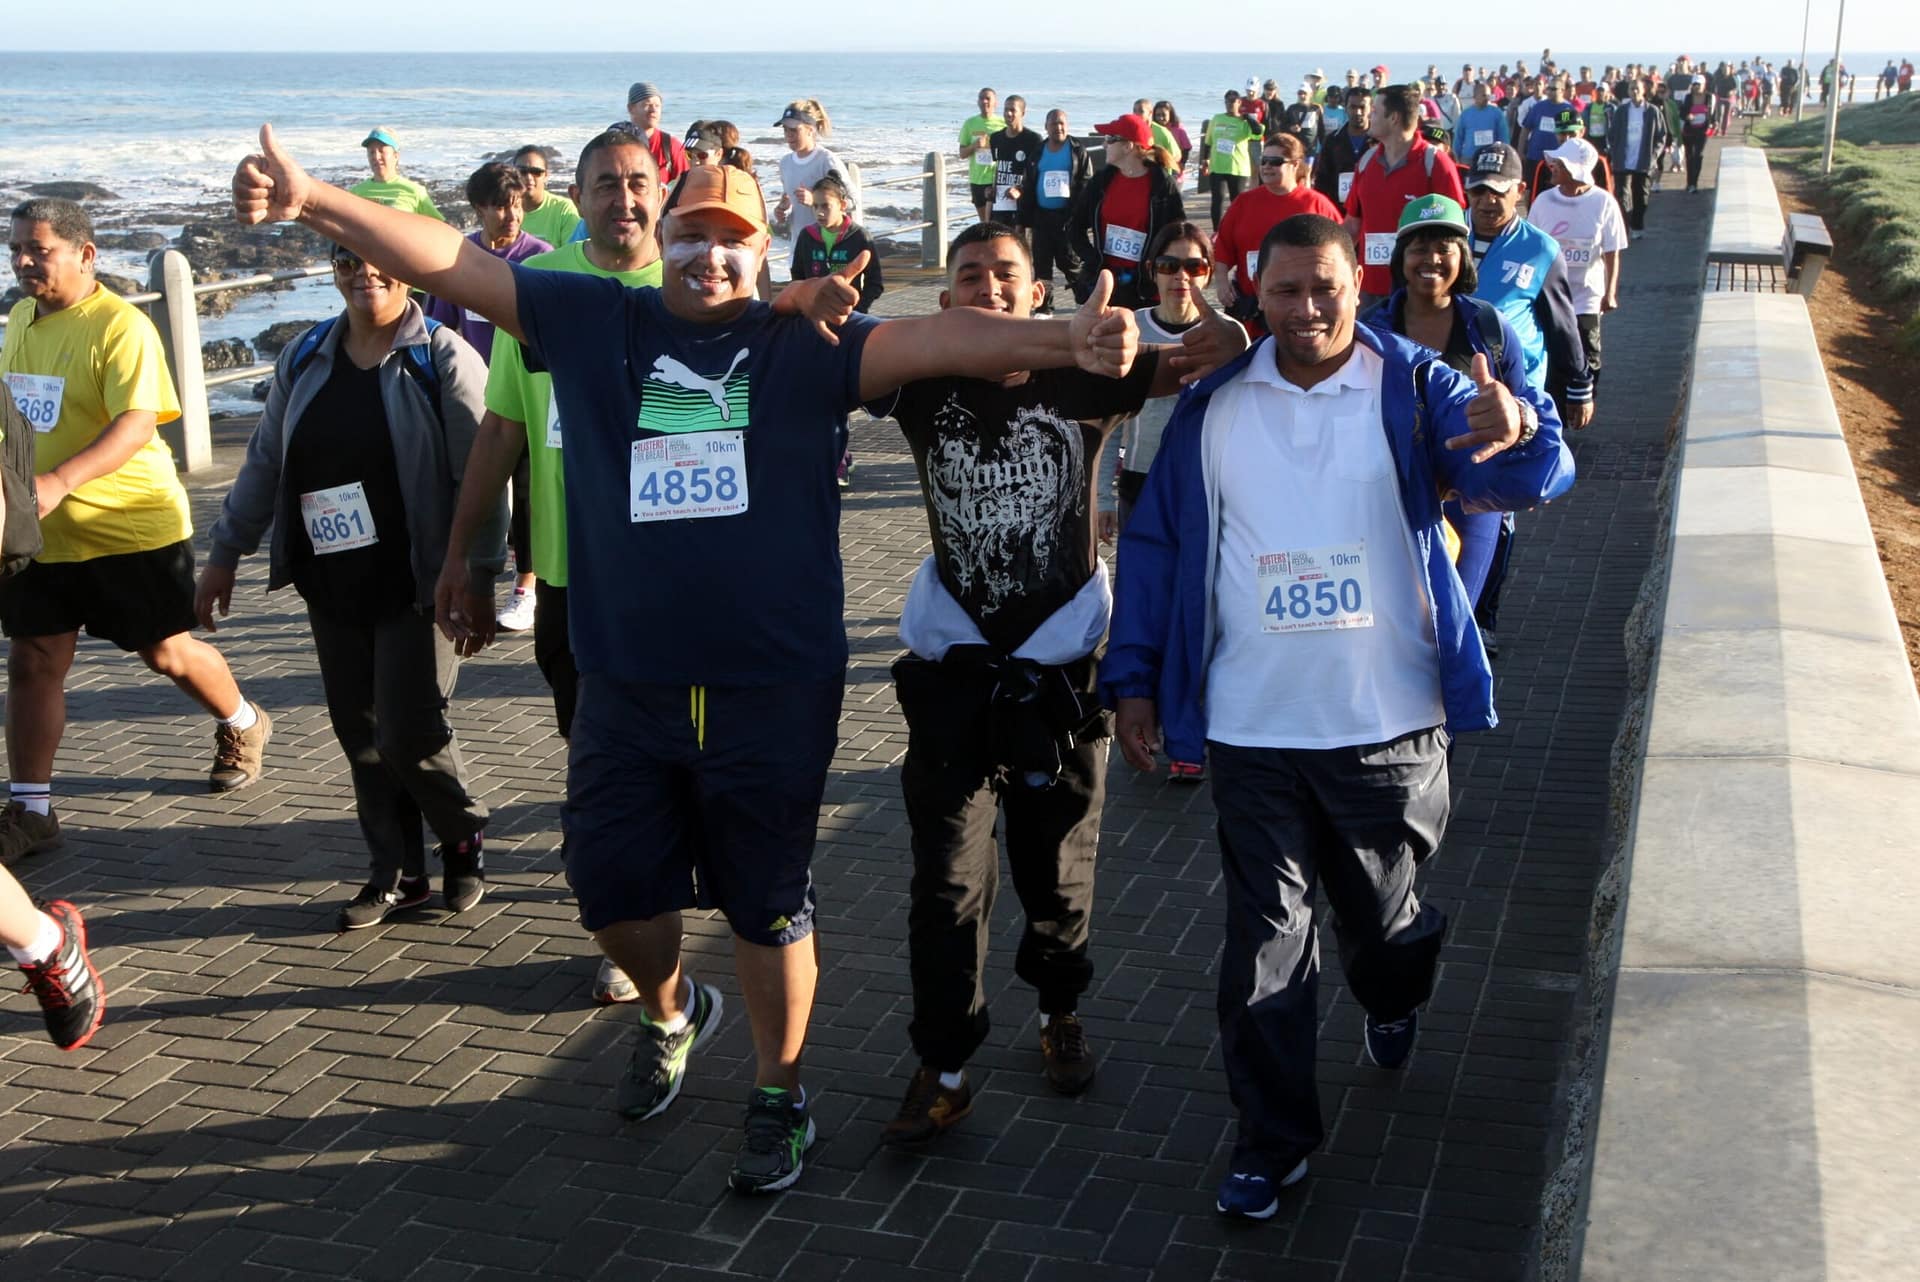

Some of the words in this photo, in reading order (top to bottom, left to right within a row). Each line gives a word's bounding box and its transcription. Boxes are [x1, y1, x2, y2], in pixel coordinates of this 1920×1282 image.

[997, 160, 1013, 172] AVE
[1477, 153, 1505, 165] FBI
[1108, 237, 1141, 255] 1635
[1366, 246, 1392, 260] 163
[1561, 248, 1590, 262] 903
[1501, 260, 1535, 290] 79
[13, 397, 55, 423] 368
[706, 441, 737, 453] 10km
[638, 466, 738, 506] 4858
[311, 509, 365, 542] 4861
[1330, 553, 1361, 566] 10km
[1265, 578, 1362, 620] 4850
